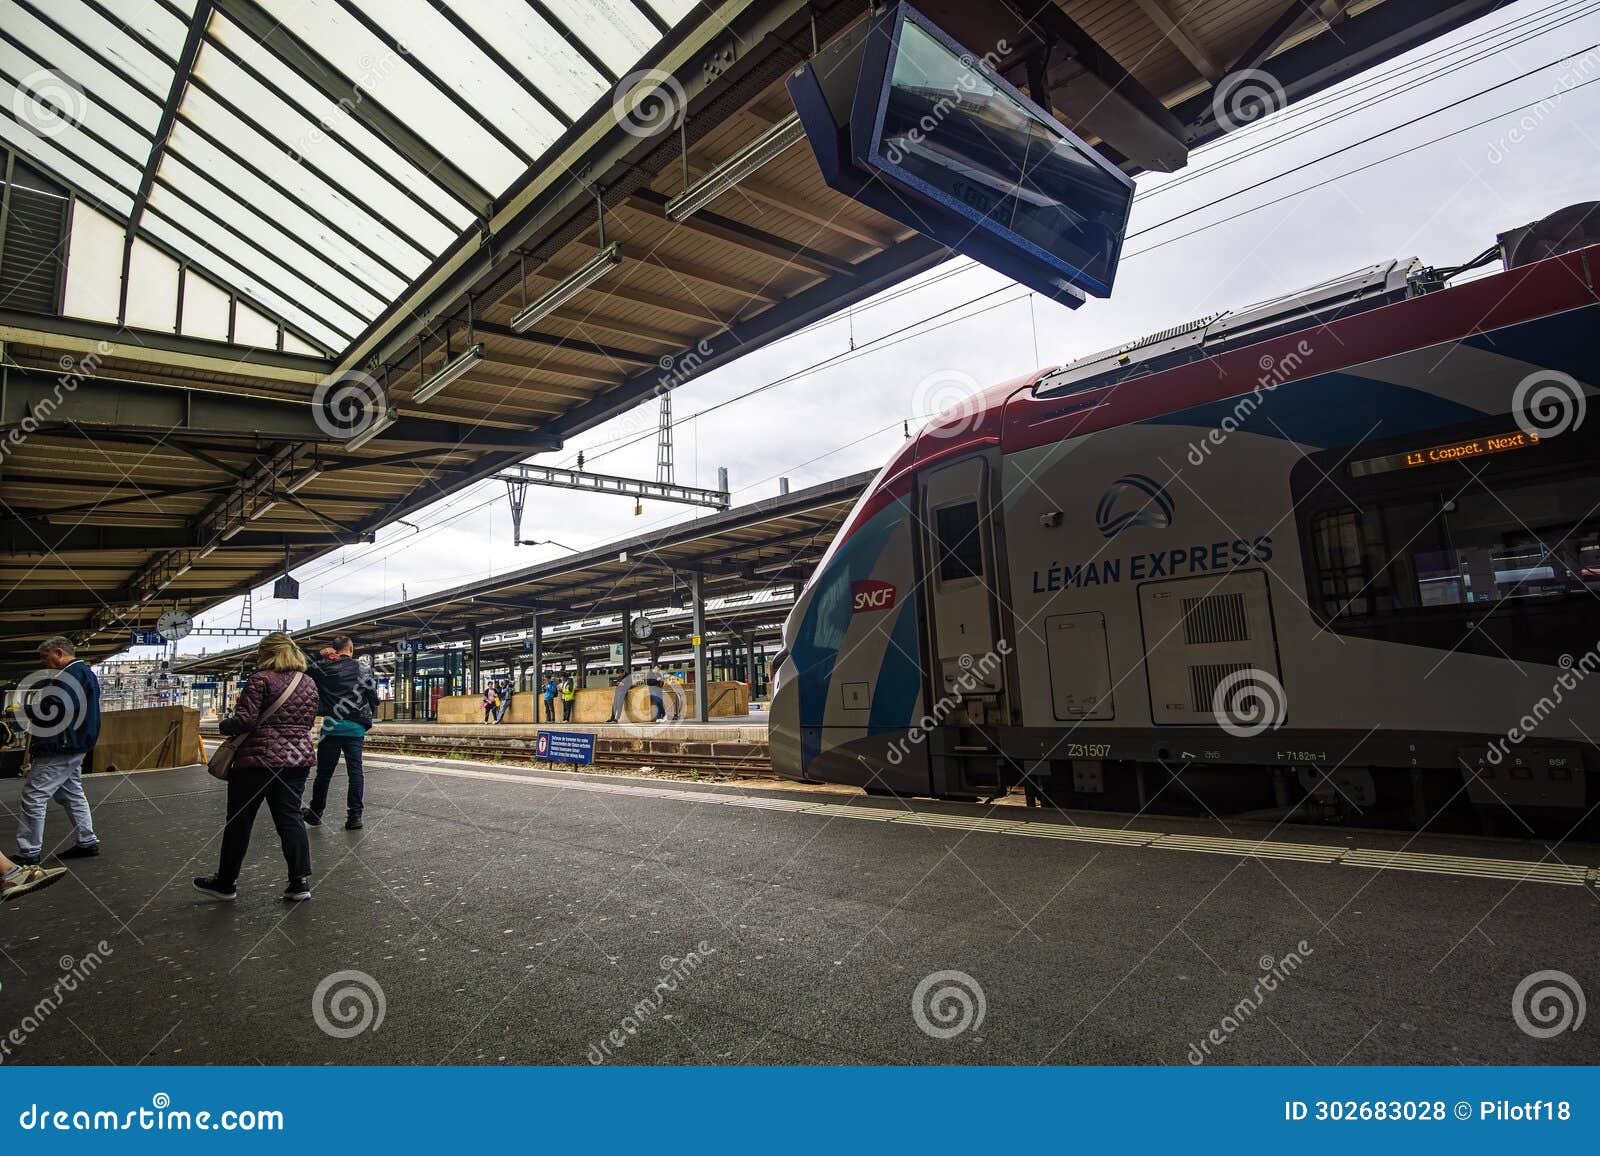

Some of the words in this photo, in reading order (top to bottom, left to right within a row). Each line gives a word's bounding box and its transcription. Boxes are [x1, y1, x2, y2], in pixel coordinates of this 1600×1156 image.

[1407, 453, 1424, 465] L1
[1488, 434, 1525, 450] Next
[1032, 558, 1120, 594] LÉMAN
[1130, 535, 1273, 581] EXPRESS
[854, 588, 893, 609] SNCF
[959, 623, 965, 634] 1
[136, 635, 144, 644] E
[1067, 744, 1111, 757] Z31507
